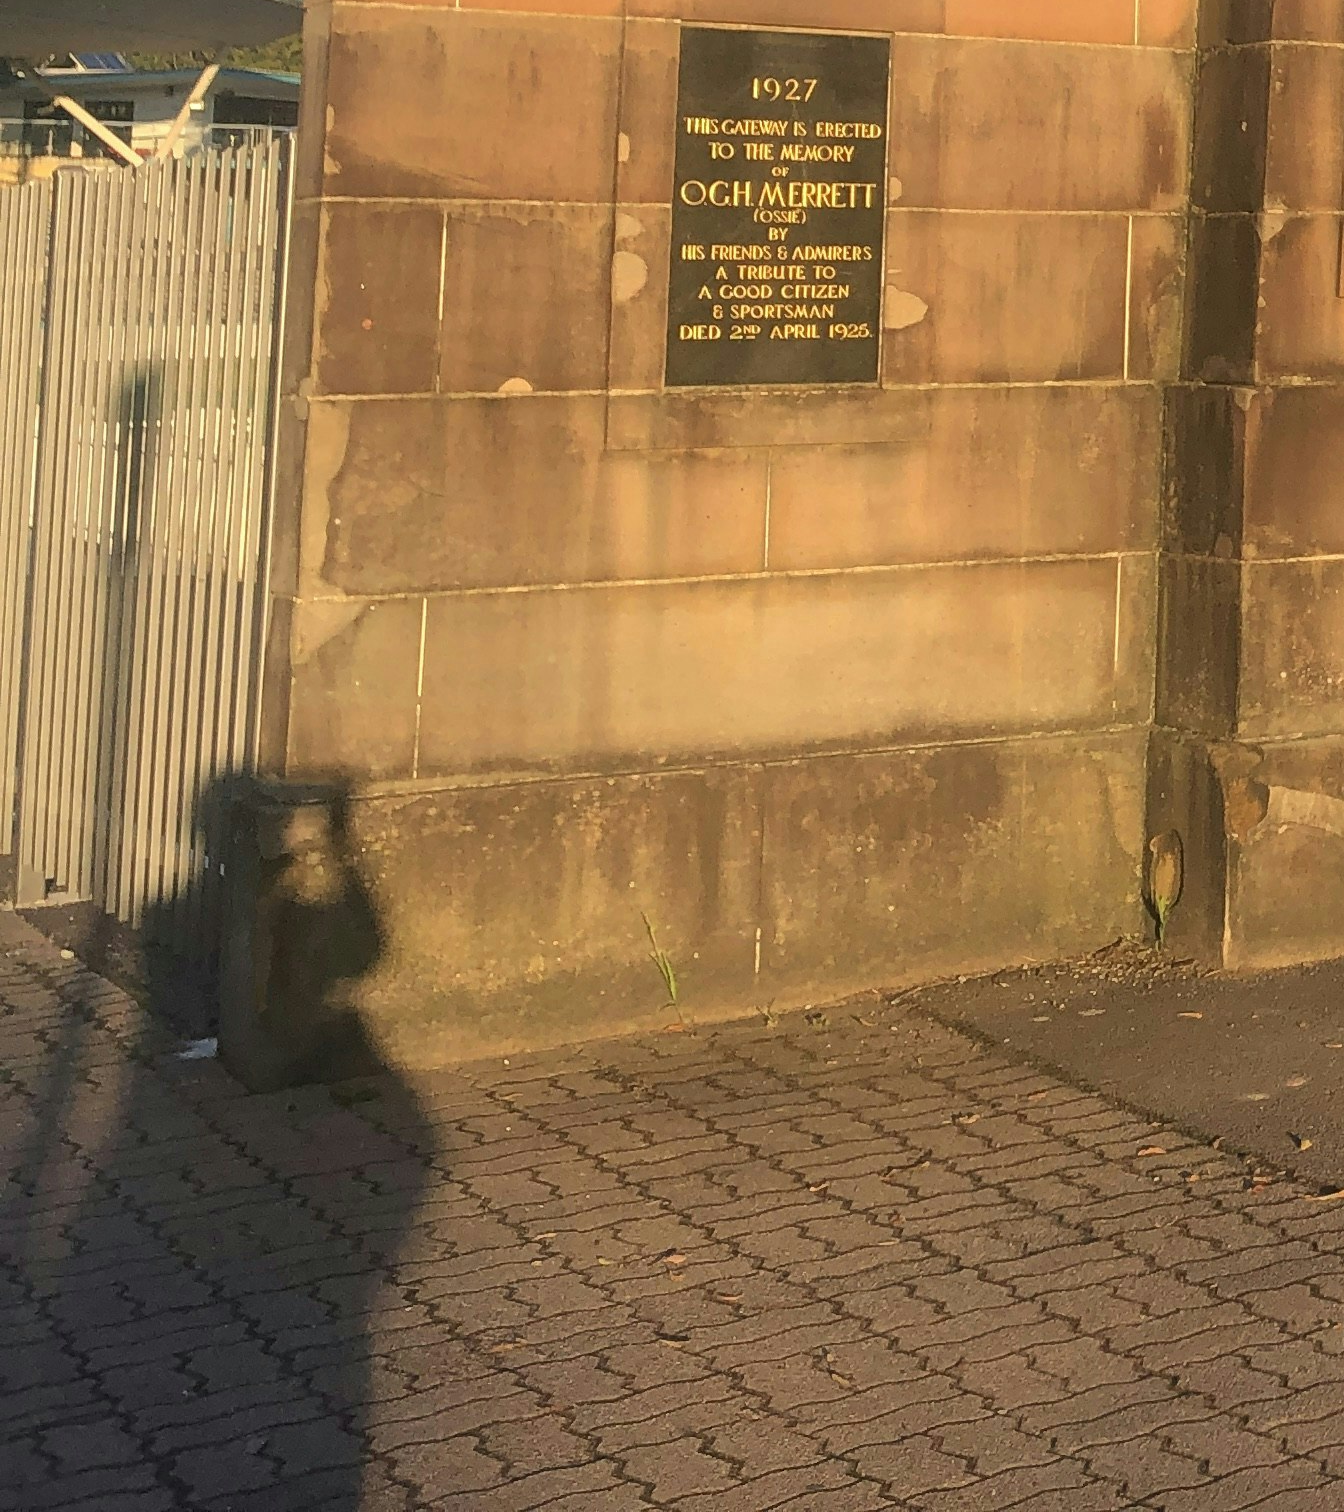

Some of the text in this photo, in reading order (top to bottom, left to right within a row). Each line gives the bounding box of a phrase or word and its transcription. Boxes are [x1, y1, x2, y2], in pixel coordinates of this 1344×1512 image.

[752, 78, 818, 102] 1927
[684, 117, 882, 138] THIS GATEWAY IS ERECTED
[709, 142, 854, 162] TO THE MEMORY
[771, 166, 790, 177] OF
[681, 180, 877, 207] O.G.H. MERRETT
[769, 227, 789, 241] BY
[682, 245, 872, 261] HIS FRIENDS & ADMIRERS
[716, 265, 836, 279] A TRIBUTE TO
[698, 285, 850, 299] A GOOD CITIZEN
[713, 305, 834, 319] & SPORTSMAN
[680, 325, 721, 340] DIED
[730, 325, 761, 339] 2ND
[770, 325, 820, 339] APRIL
